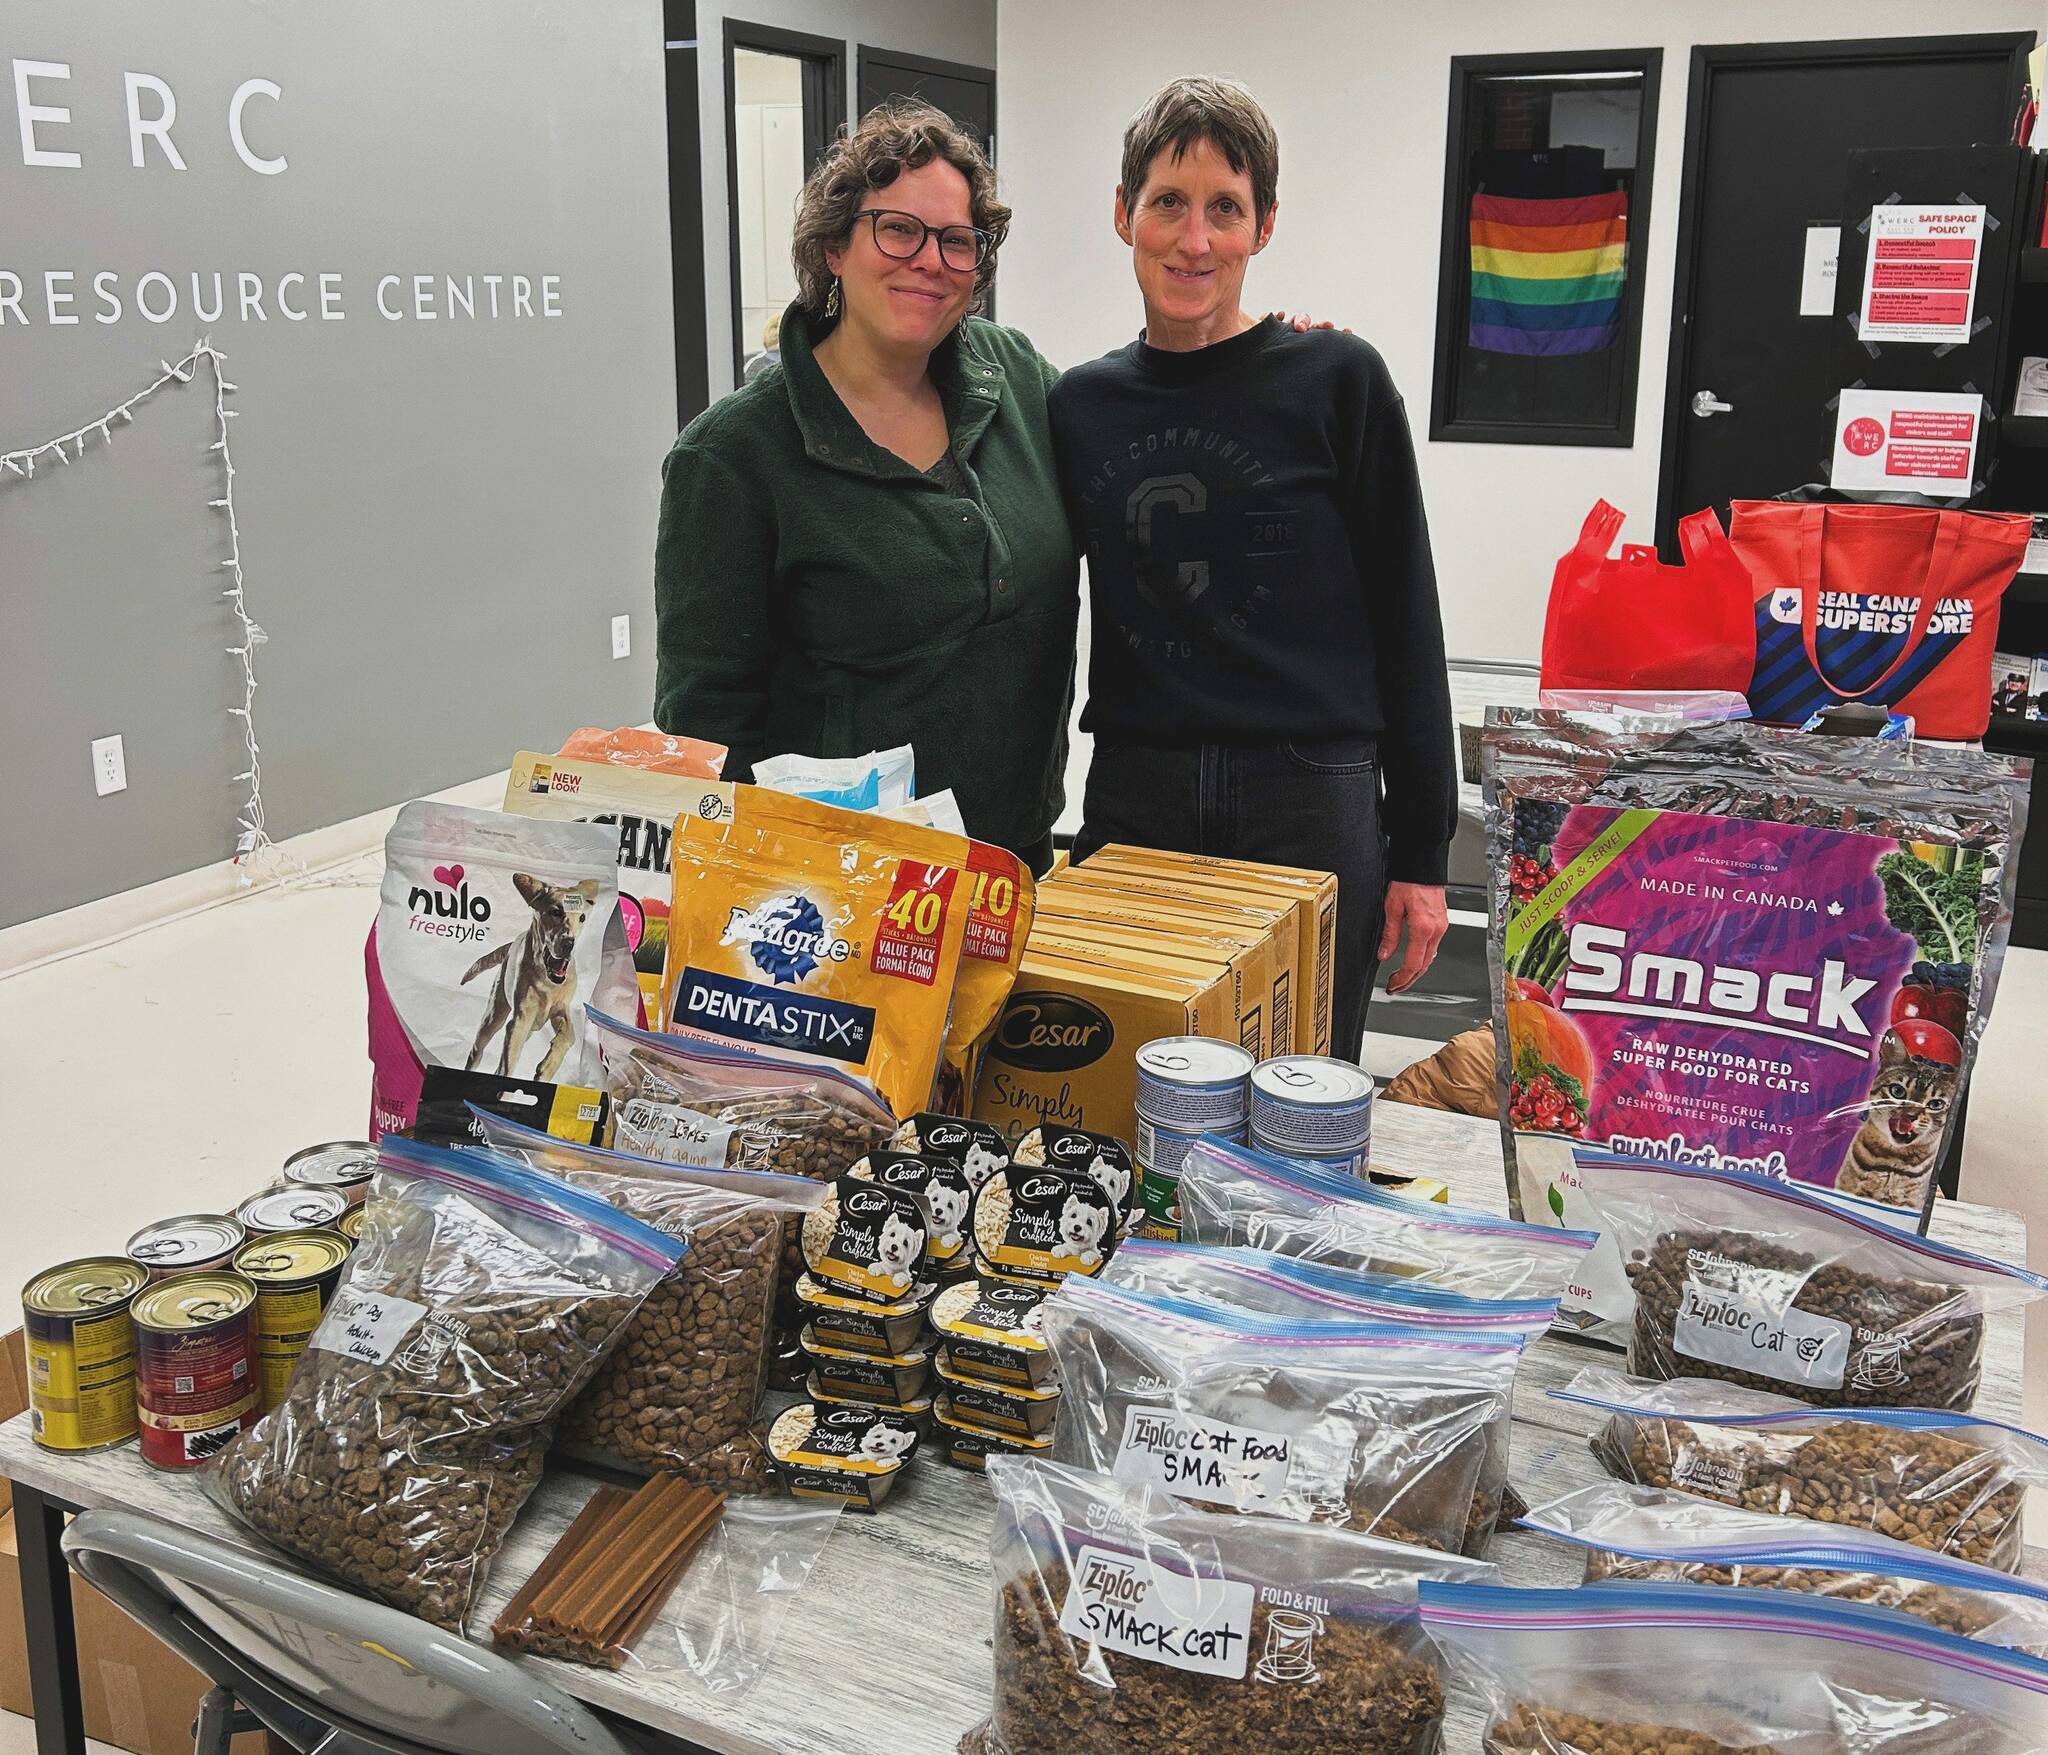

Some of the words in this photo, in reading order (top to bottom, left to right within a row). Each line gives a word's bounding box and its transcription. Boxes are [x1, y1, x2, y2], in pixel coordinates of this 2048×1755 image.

[1919, 215, 1943, 223] SAFE
[1944, 215, 1977, 223] SPACE
[1929, 226, 1966, 234] POLICY
[0, 271, 346, 325] RESOURCE
[376, 274, 562, 320] CENTRE
[1080, 460, 1118, 505] THE
[1128, 427, 1276, 487] COMMUNITY
[1818, 590, 1860, 609] REAL
[1866, 594, 1974, 613] CANAIAN
[551, 783, 579, 793] LOOK!
[552, 772, 582, 786] NEW
[1519, 908, 1543, 934] JUST
[1543, 876, 1574, 911] SCOOP
[1577, 865, 1588, 878] &
[1586, 831, 1623, 867] SERVE!
[1640, 878, 1697, 897] MADE
[1704, 886, 1725, 899] IN
[1732, 889, 1818, 913] CANADA
[408, 880, 491, 923] nulo
[888, 889, 942, 935] 40
[408, 915, 486, 943] freestyle
[984, 927, 1007, 944] PACK
[880, 940, 908, 958] VALUE
[911, 946, 935, 963] PACK
[876, 956, 906, 973] FORMAT
[908, 960, 932, 980] ÉCONO
[1565, 923, 1878, 1037] Smack
[688, 985, 855, 1047] DENTASTIX
[996, 1004, 1103, 1050] Cesar
[1632, 1038, 1670, 1055] RAW
[1675, 1046, 1793, 1076] DEHYDRATED
[1612, 1050, 1666, 1070] SUPER
[1671, 1061, 1719, 1078] FOOD
[1725, 1070, 1760, 1086] FOR
[1766, 1076, 1811, 1094] CATS
[990, 1073, 1084, 1130] Simply
[1617, 1095, 1706, 1120] DÉSHYDRATÉE
[1711, 1113, 1747, 1128] POUR
[1751, 1121, 1794, 1136] CHATS
[1645, 1089, 1727, 1113] NOURRITURE
[1732, 1105, 1766, 1119] CRUE
[929, 1126, 969, 1144] Cesar
[972, 1131, 978, 1142] 1
[1054, 1137, 1092, 1155] Cesar
[1096, 1144, 1102, 1155] 1
[672, 1145, 709, 1168] aging
[884, 1164, 925, 1182] Cesar
[931, 1167, 937, 1177] 1
[848, 1192, 888, 1211] Cesar
[891, 1200, 898, 1211] 1
[1021, 1178, 1063, 1198] Cesar
[1069, 1182, 1075, 1194] 1
[838, 1220, 875, 1249] Simply
[1013, 1208, 1055, 1235] Simply
[991, 1288, 1037, 1302] Cesar
[1568, 1284, 1592, 1300] CUPS
[366, 1304, 383, 1322] Dog
[426, 1309, 446, 1324] FOLD
[452, 1320, 472, 1338] FILL
[975, 1303, 1019, 1322] Simply
[1690, 1294, 1752, 1330] Ziploc
[1751, 1322, 1787, 1352] Cat
[1857, 1327, 1885, 1343] FOLD
[349, 1341, 381, 1360] Chicken
[828, 1411, 873, 1424] Cesar
[812, 1428, 856, 1446] Simply
[1136, 1419, 1187, 1453] Ziploc
[1190, 1429, 1237, 1453] Cat
[1242, 1438, 1288, 1462] Food
[1086, 1562, 1147, 1603] Ziploc
[1261, 1587, 1291, 1607] FOLD
[1293, 1592, 1305, 1609] &
[1305, 1595, 1331, 1616] FILL
[1079, 1603, 1181, 1657] SMACK
